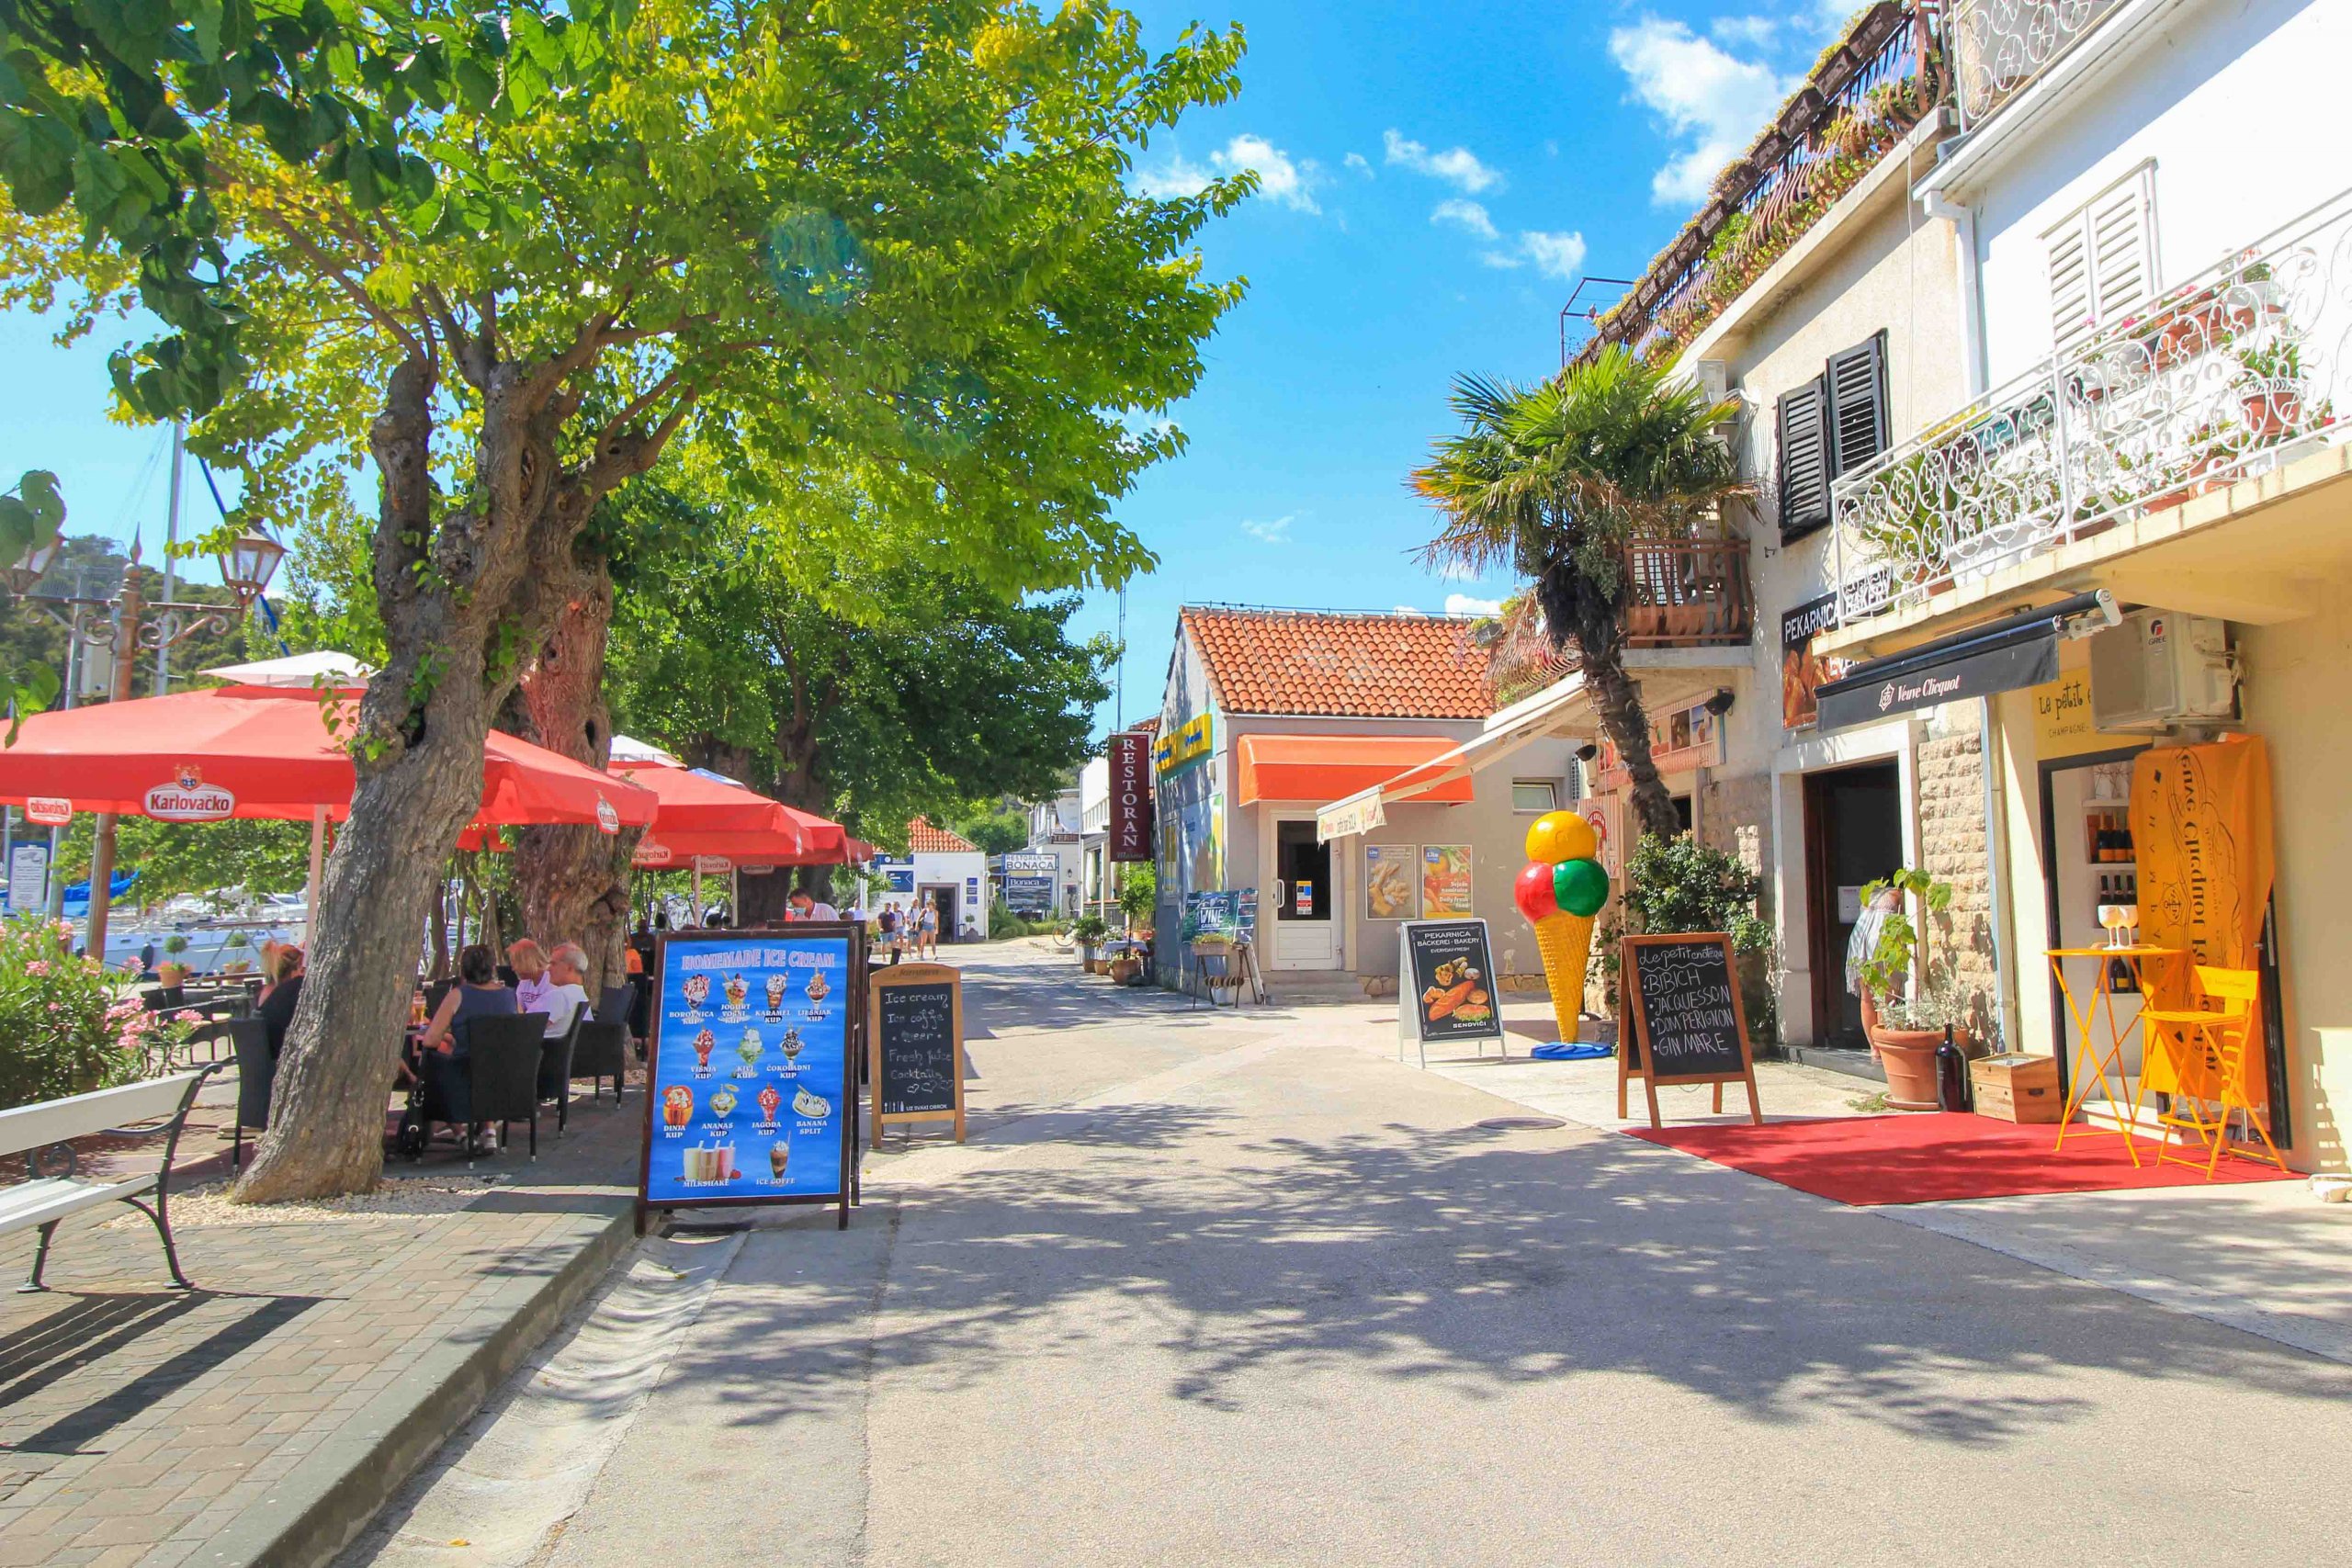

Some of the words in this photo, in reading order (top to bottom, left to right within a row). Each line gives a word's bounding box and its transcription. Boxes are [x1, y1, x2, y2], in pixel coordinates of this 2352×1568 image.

[1785, 600, 1838, 643] PEKARNICA
[2148, 636, 2166, 646] GREE
[1897, 684, 1921, 702] Veuve
[1922, 674, 1961, 696] Clicquot
[2039, 697, 2051, 715] Le
[2055, 680, 2083, 720] petit
[151, 793, 230, 812] Karlovačko
[1122, 739, 1138, 847] RESTORAN
[1200, 908, 1224, 924] WINE
[1424, 931, 1471, 939] PEKARNICA
[682, 949, 761, 970] HOMEMADE
[763, 949, 786, 967] ICE
[788, 951, 835, 967] CREAM
[1661, 945, 1691, 967] petit
[1645, 968, 1701, 996] BIBICH
[885, 993, 906, 1004] Ice
[910, 994, 948, 1008] cream
[1654, 985, 1730, 1016] JACQUESSON
[1654, 1016, 1680, 1035] DOM
[1679, 1008, 1735, 1031] PERIGNON
[1658, 1037, 1681, 1056] GIN
[1684, 1032, 1729, 1054] MARE
[684, 1179, 729, 1188] MILKSHAKE
